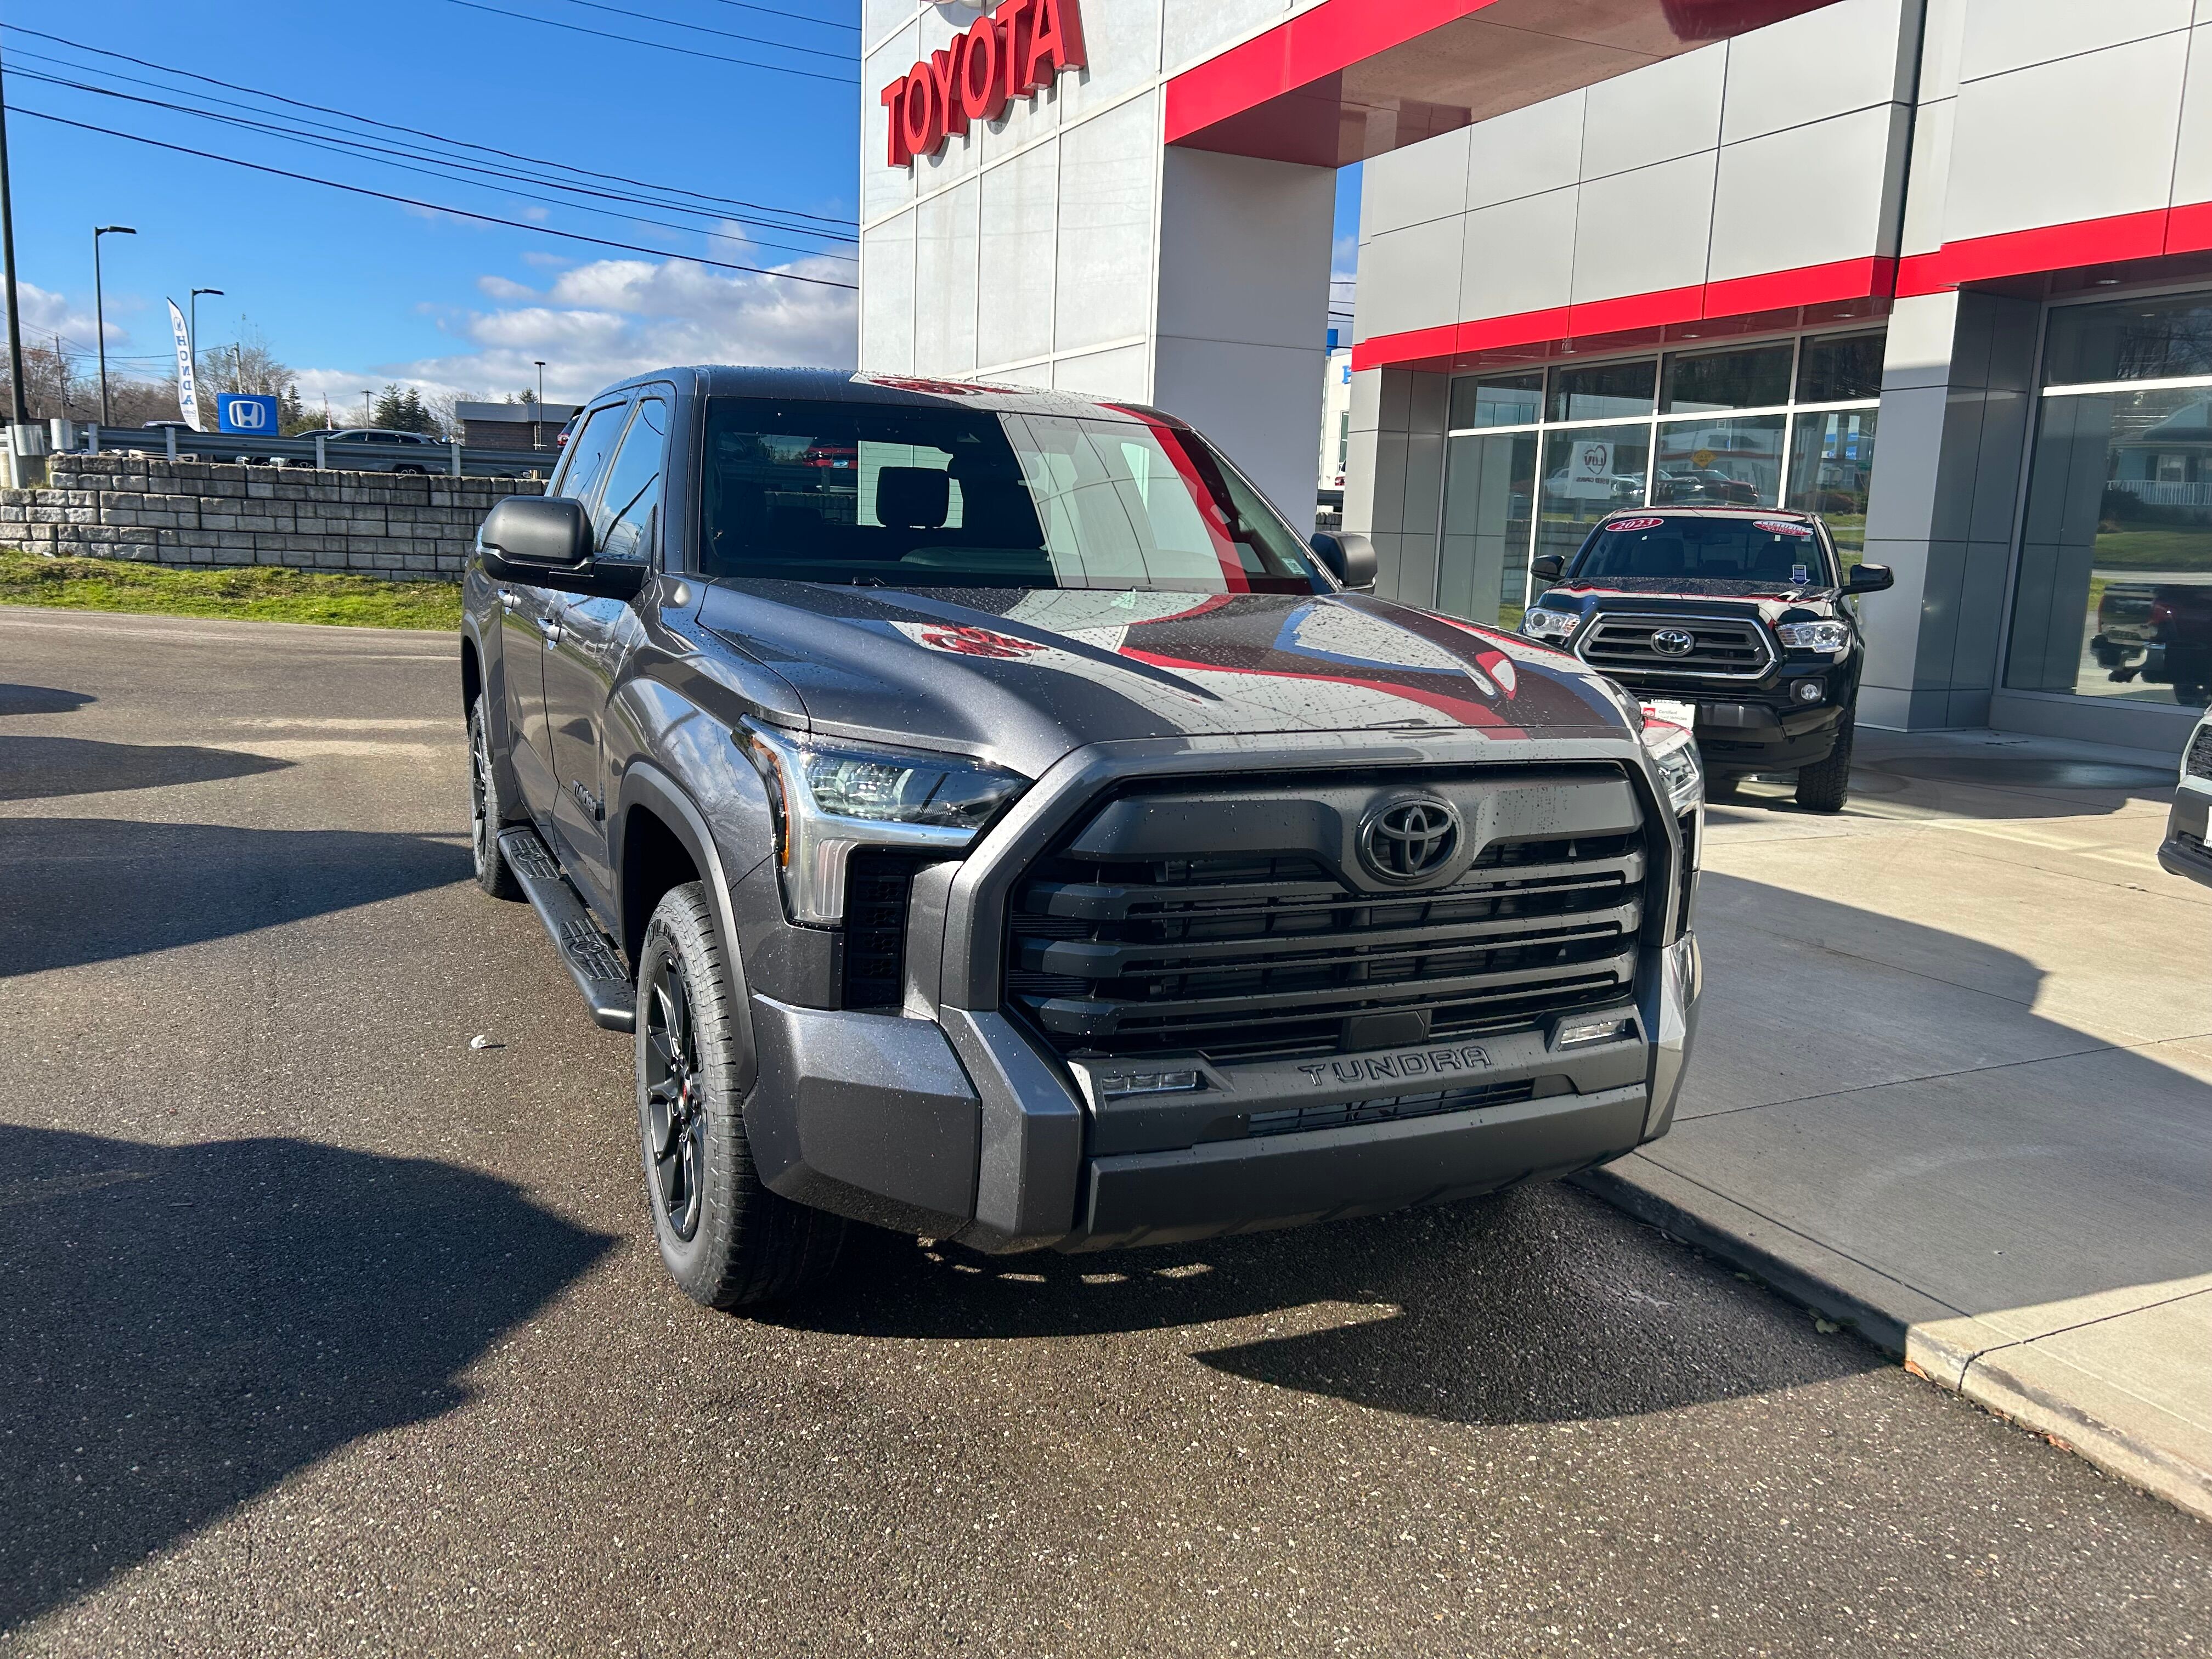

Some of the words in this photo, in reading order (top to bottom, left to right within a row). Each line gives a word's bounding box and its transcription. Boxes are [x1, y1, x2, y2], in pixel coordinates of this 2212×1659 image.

[881, 0, 1085, 169] TOYOTA
[1615, 519, 1654, 530] 2023
[1297, 1046, 1492, 1086] TUNDRA
